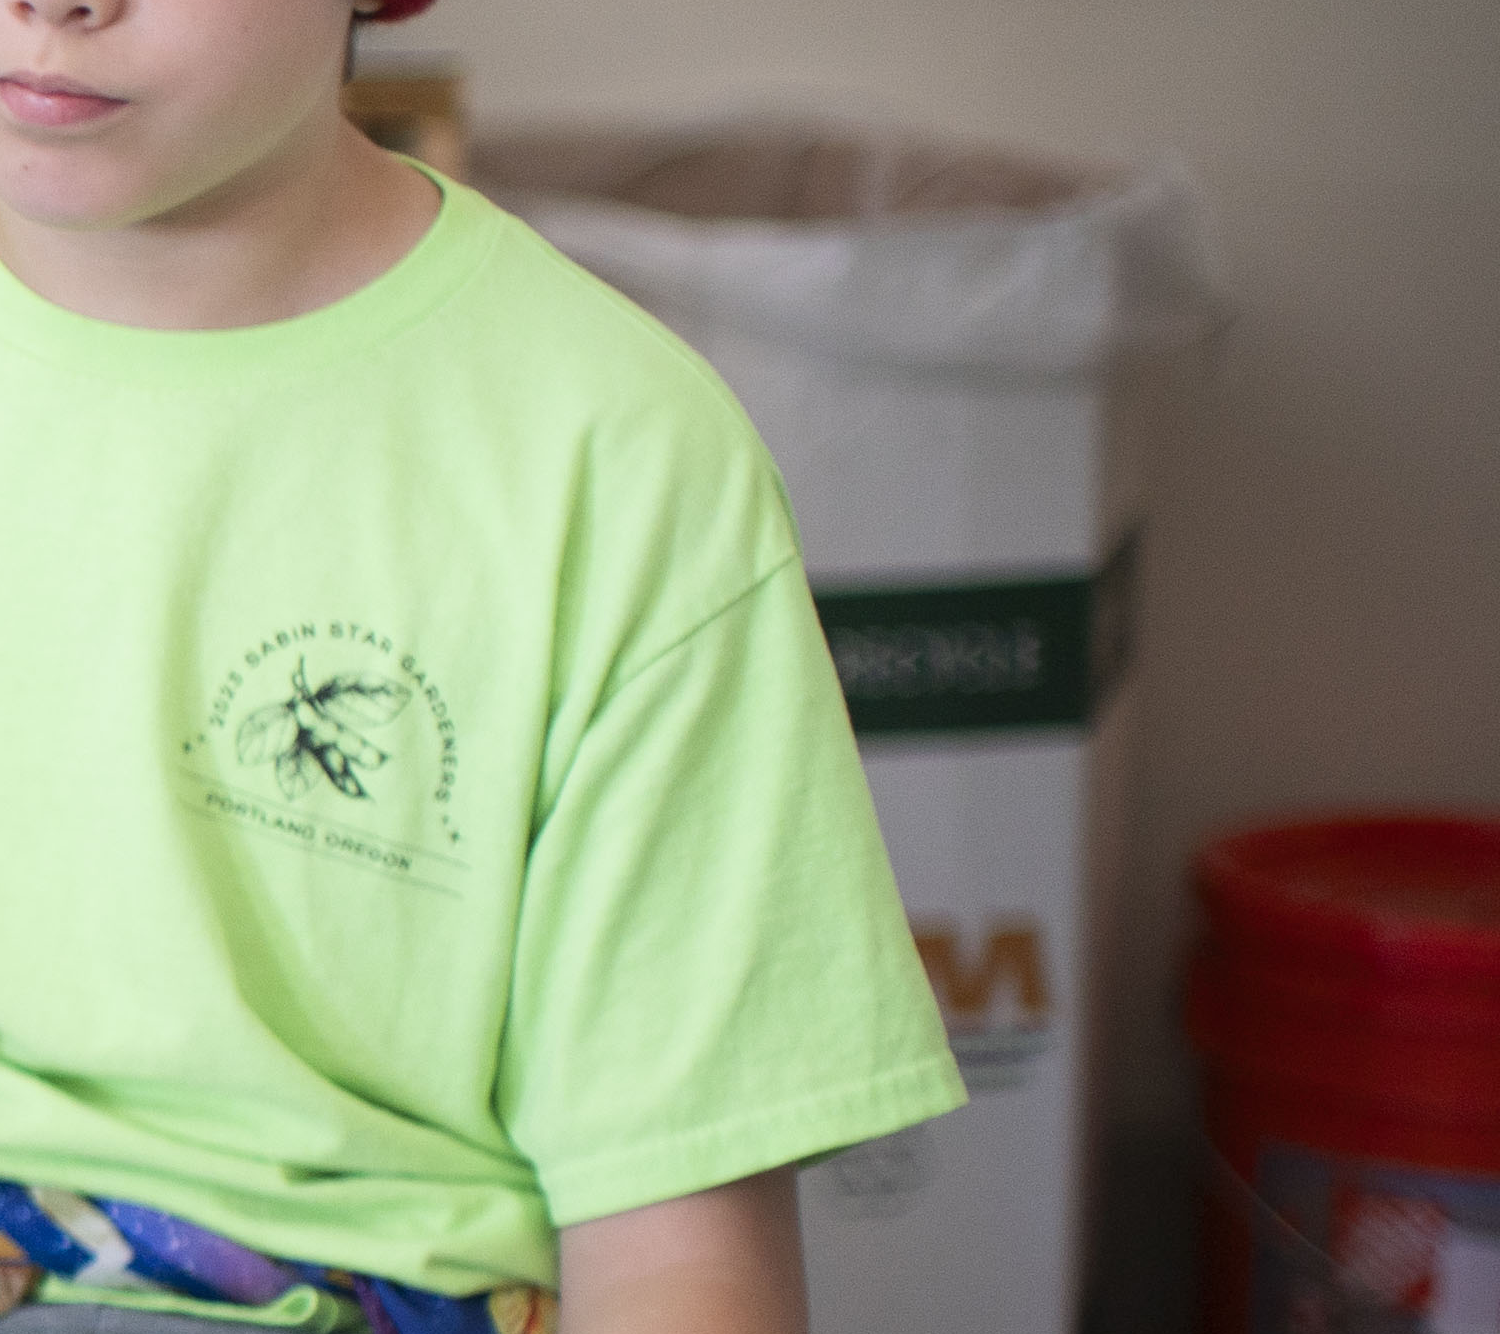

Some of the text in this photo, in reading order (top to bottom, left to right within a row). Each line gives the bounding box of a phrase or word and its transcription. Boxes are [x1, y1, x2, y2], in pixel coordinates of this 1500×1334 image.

[244, 622, 316, 668] SABIN
[329, 621, 393, 655] STAR
[400, 653, 459, 805] GARDENERS
[205, 791, 413, 871] PORTLAND OREGON
